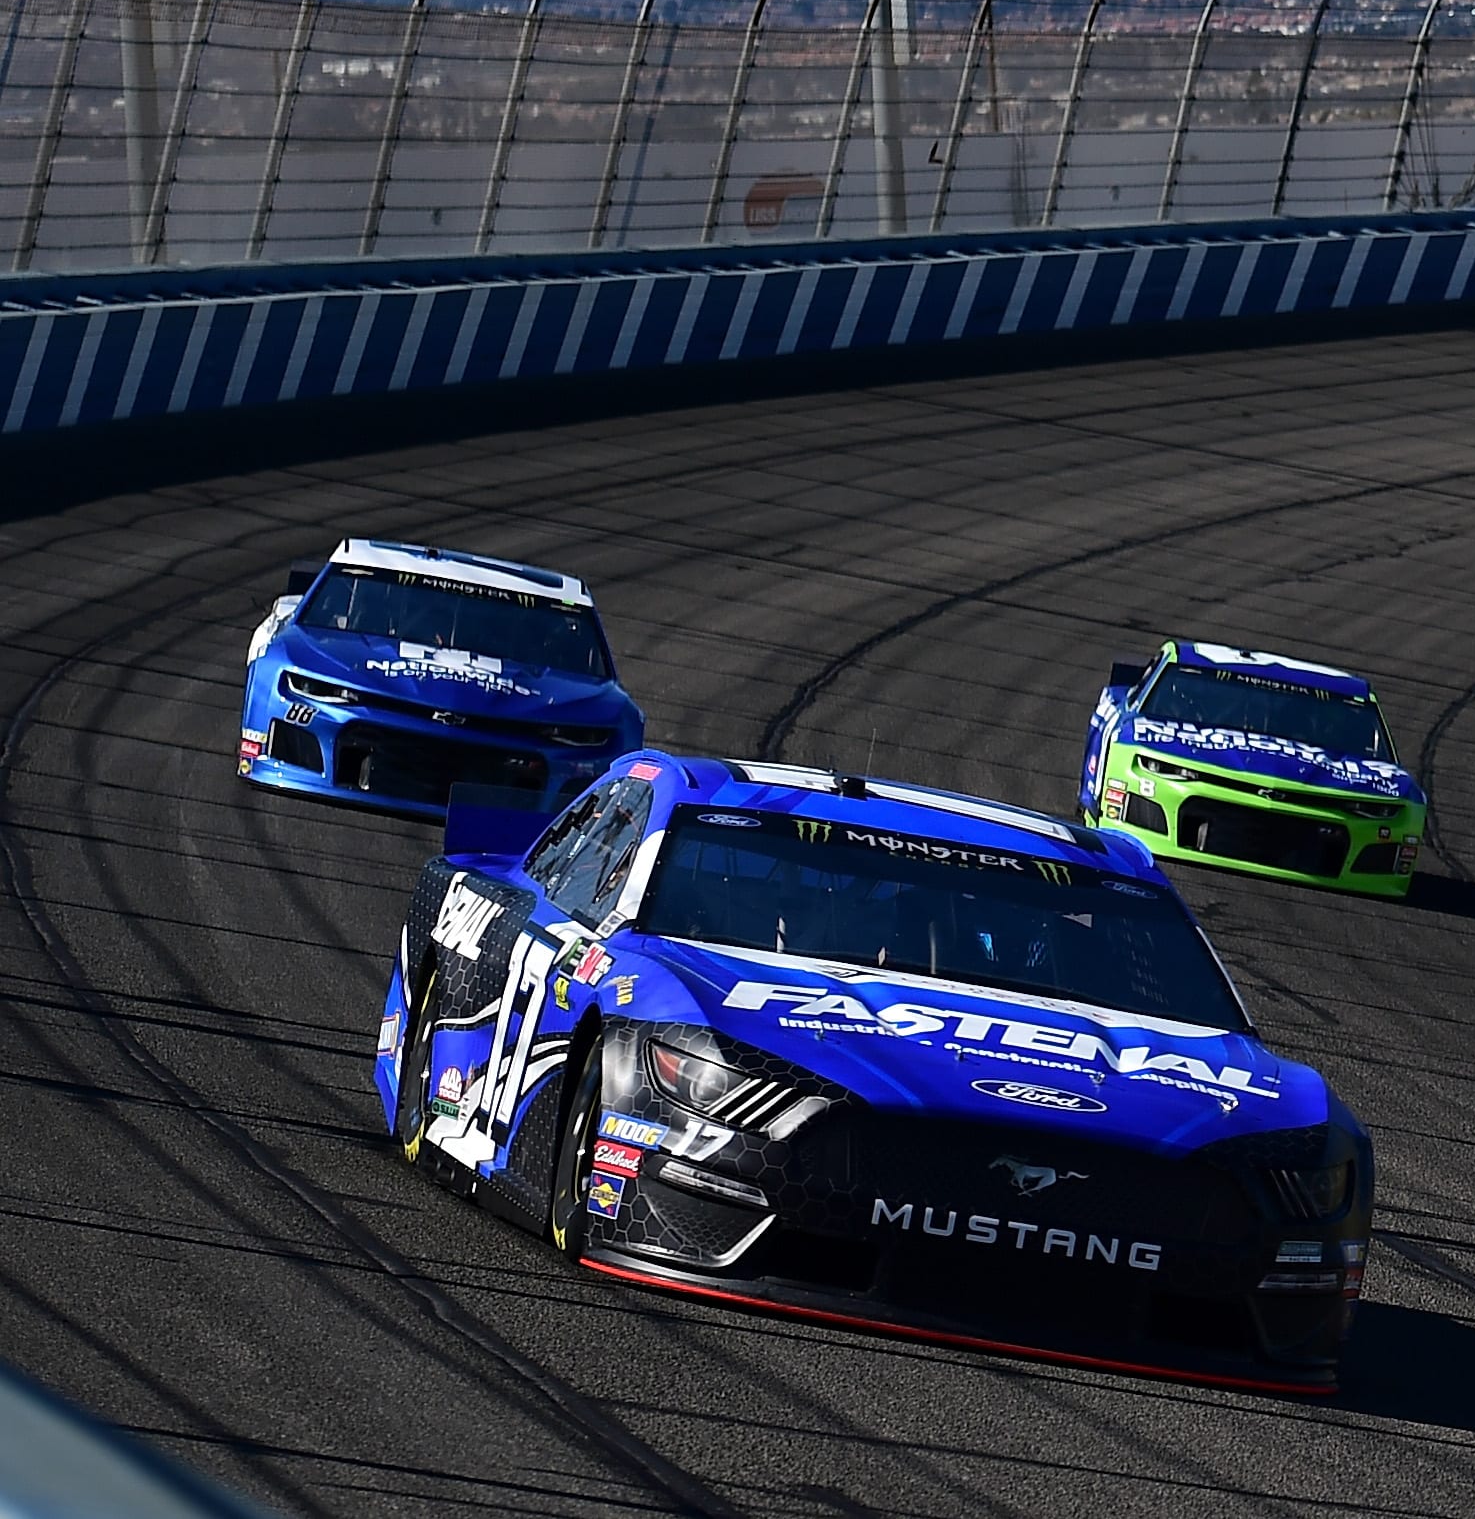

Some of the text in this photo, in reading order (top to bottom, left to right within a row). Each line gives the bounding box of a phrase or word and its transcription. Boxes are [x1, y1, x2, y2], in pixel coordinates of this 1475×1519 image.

[423, 578, 511, 600] MONSTER
[286, 703, 319, 726] 88
[1140, 778, 1156, 797] 8
[845, 830, 1024, 871] MONSTER
[480, 930, 558, 1124] 17
[721, 980, 1280, 1099] FASTENAL
[997, 1082, 1081, 1109] Ford
[602, 1116, 665, 1147] MOOG
[671, 1118, 737, 1162] 17
[594, 1144, 641, 1173] Edelbrock
[871, 1198, 1162, 1271] MUSTANG
